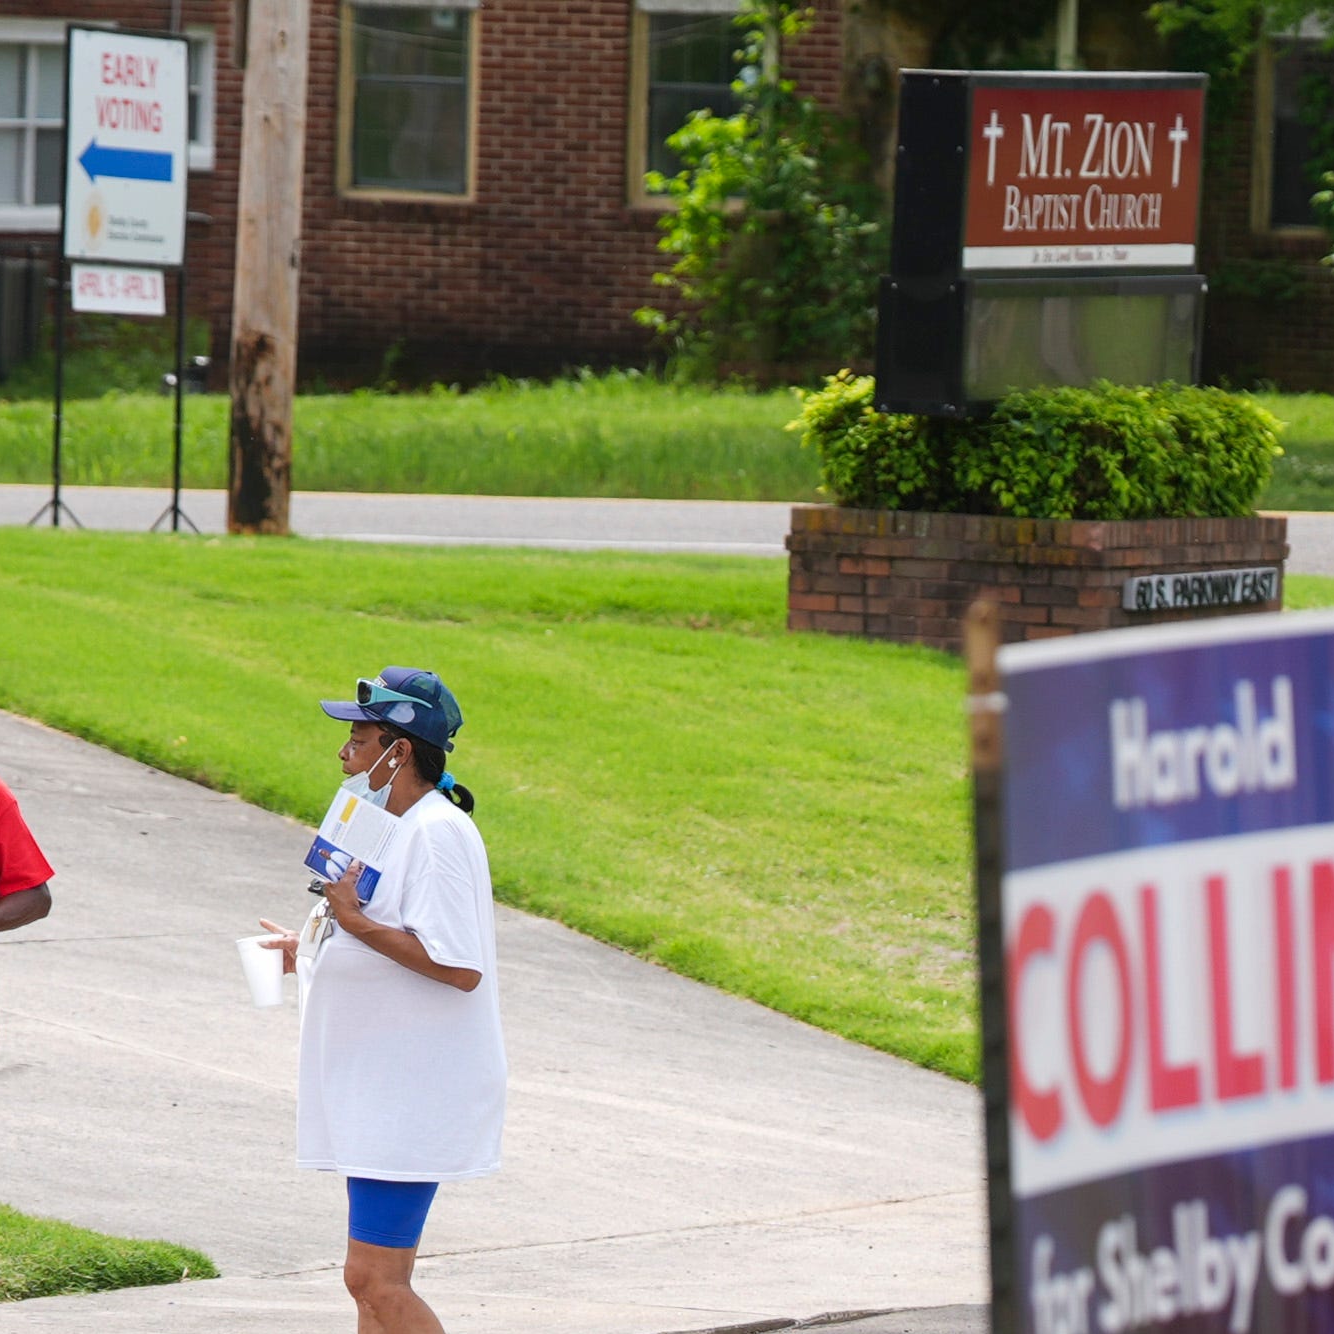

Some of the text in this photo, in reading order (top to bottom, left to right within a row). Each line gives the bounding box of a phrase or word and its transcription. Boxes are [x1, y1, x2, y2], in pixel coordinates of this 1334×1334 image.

[101, 52, 159, 89] EARLY
[95, 96, 163, 133] VOTING
[1172, 574, 1238, 607] PARKWAY
[1241, 571, 1275, 602] EAST
[1109, 676, 1297, 812] Harold
